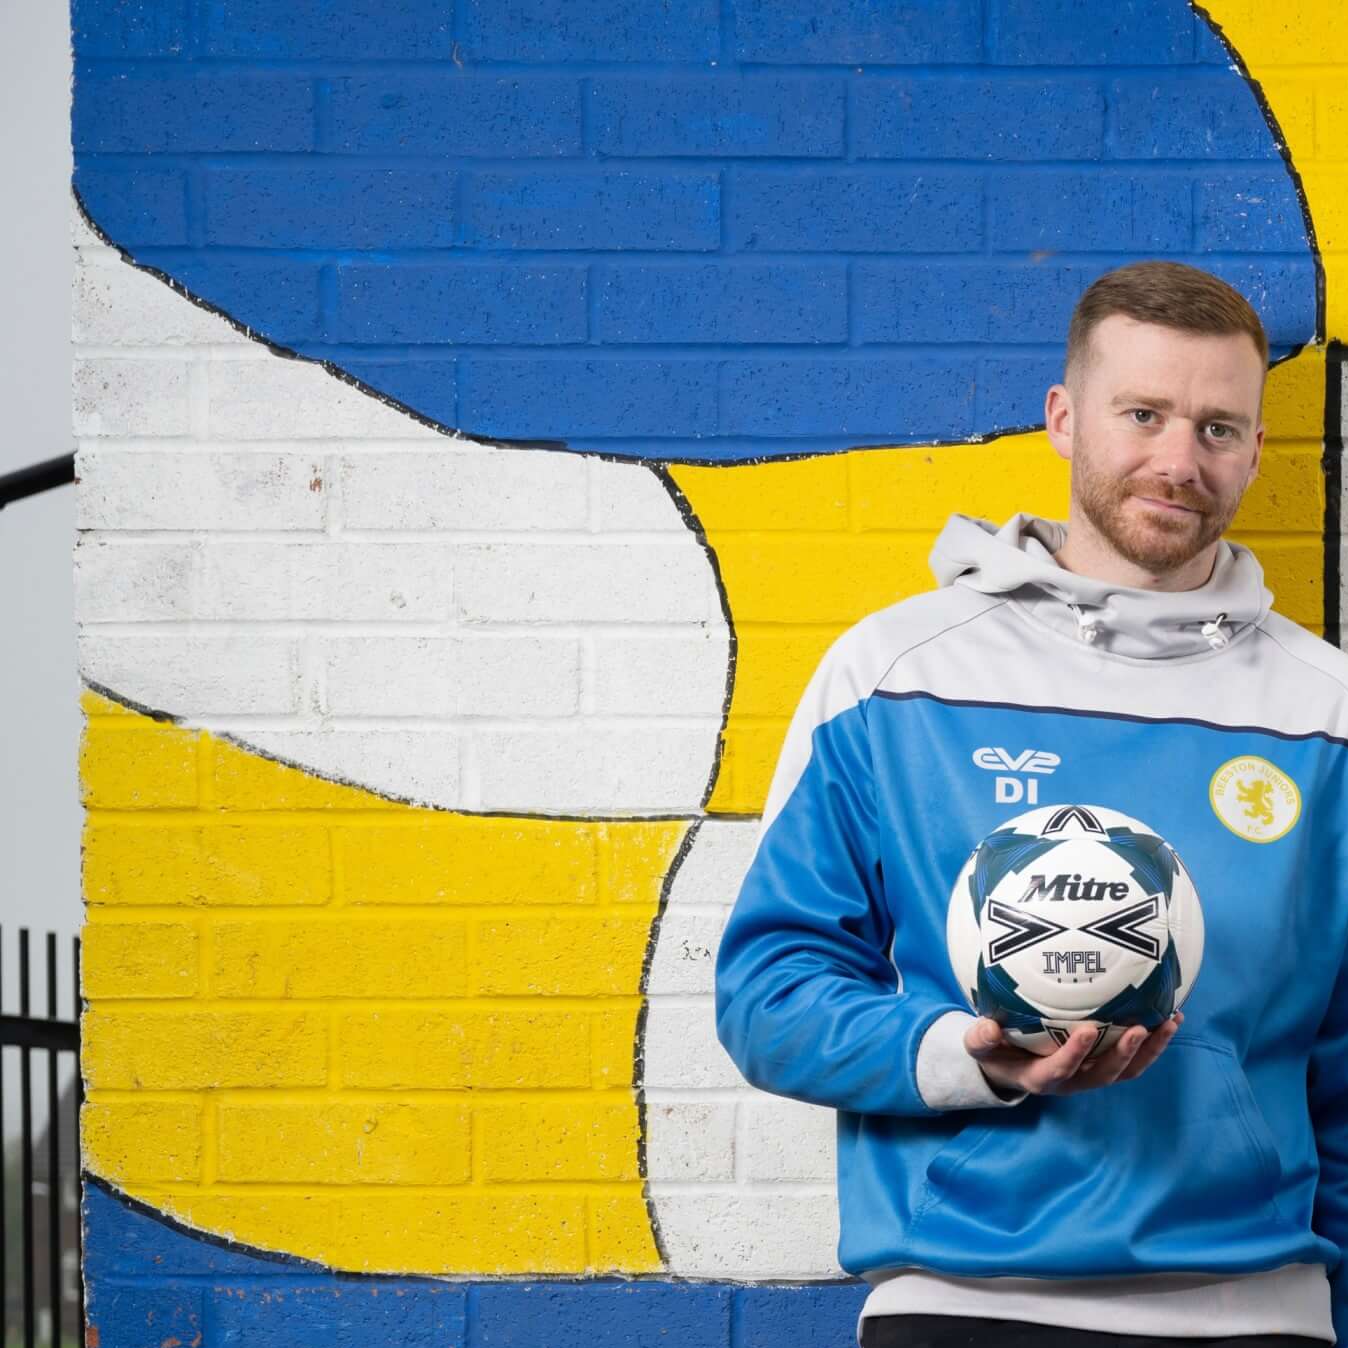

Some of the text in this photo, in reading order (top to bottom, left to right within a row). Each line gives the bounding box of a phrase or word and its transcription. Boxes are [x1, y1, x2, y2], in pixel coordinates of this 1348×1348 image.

[995, 777, 1037, 804] DI
[1018, 874, 1129, 902] Mitre
[1042, 951, 1106, 974] IMPEL
